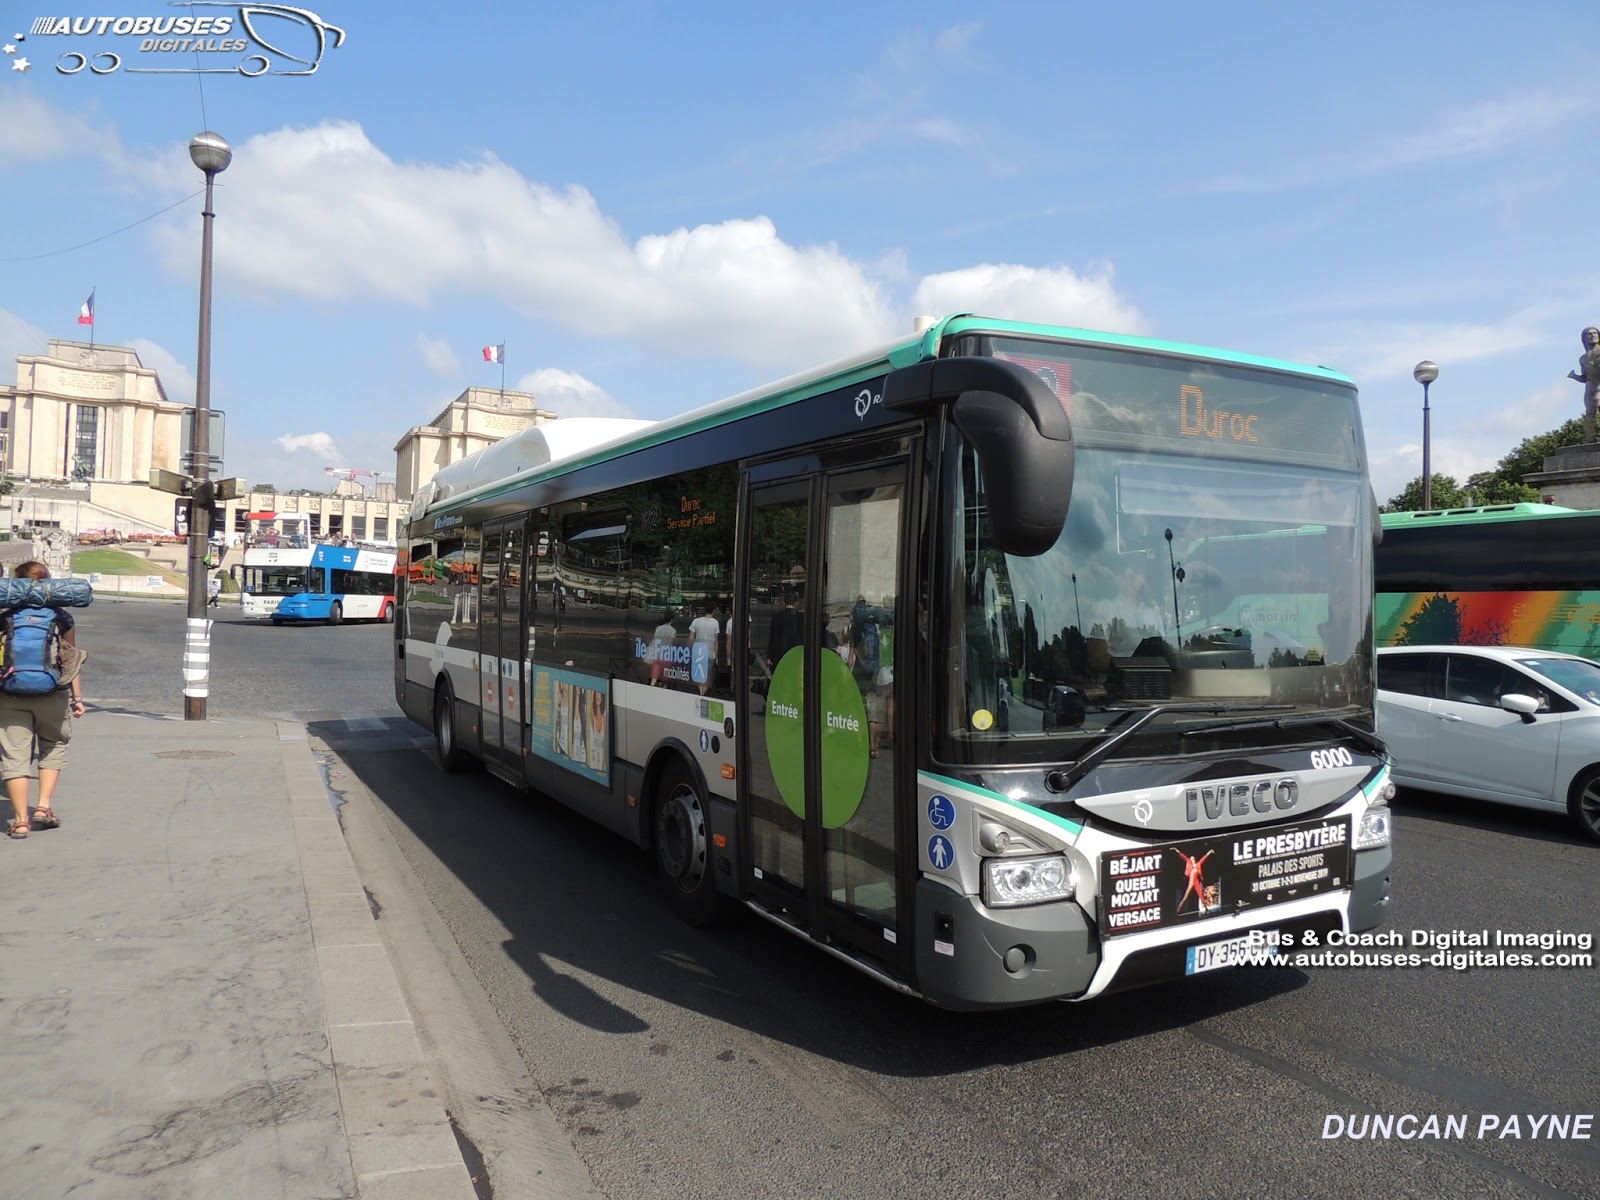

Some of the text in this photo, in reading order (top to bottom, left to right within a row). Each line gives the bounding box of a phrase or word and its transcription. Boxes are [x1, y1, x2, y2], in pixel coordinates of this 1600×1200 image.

[1180, 384, 1258, 442] Duroc
[681, 496, 702, 513] Duroc
[667, 511, 716, 530] Service Partiel
[663, 667, 690, 682] mobilités
[771, 700, 798, 719] Entrée
[826, 711, 860, 732] Entrée
[1310, 746, 1353, 770] 6000
[1186, 777, 1299, 823] IVECO
[1233, 840, 1253, 861] LE
[1256, 821, 1347, 857] PRESBYTÈRE
[1109, 854, 1162, 875] BÉJART
[1258, 861, 1283, 879] PALAIS
[1284, 857, 1298, 874] DES
[1299, 853, 1325, 870] SPORTS
[1115, 875, 1156, 894] QUEEN
[1251, 882, 1259, 893] 31
[1111, 888, 1160, 908] MOZART
[1108, 907, 1161, 928] VERSACE
